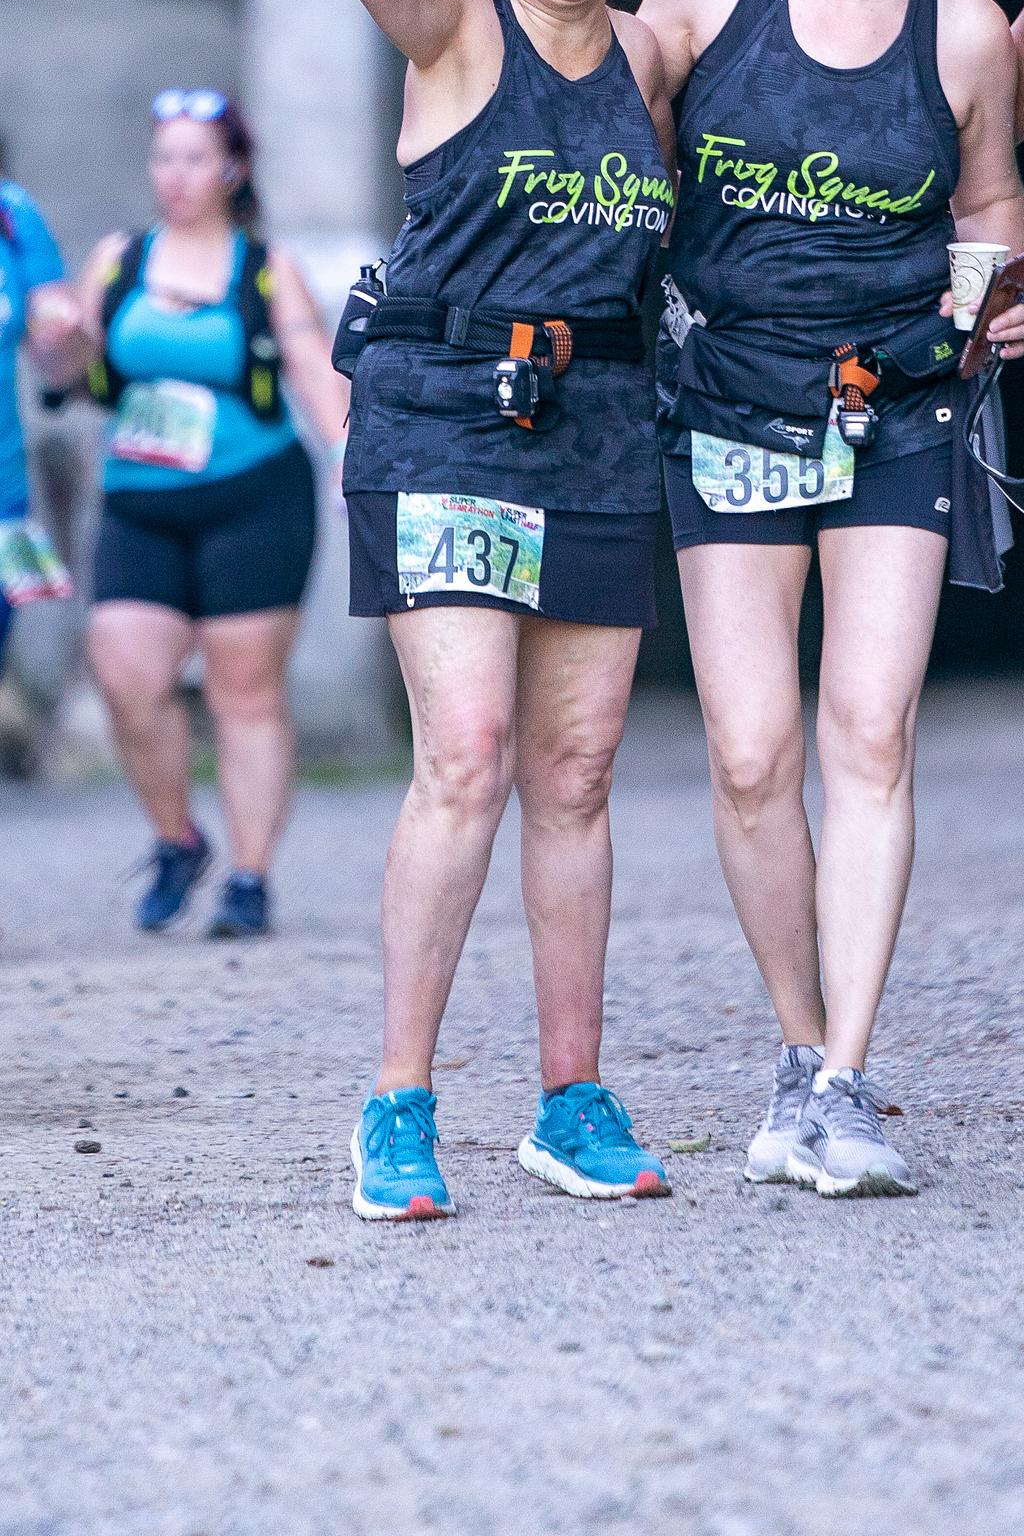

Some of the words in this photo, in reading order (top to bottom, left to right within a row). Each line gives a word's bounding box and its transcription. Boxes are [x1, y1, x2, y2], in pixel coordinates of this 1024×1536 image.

[496, 149, 586, 223] Frog
[695, 133, 778, 209] Frog
[786, 150, 936, 222] Squad
[528, 201, 669, 234] COVINGTON
[724, 449, 825, 506] 355
[428, 527, 519, 593] 437
